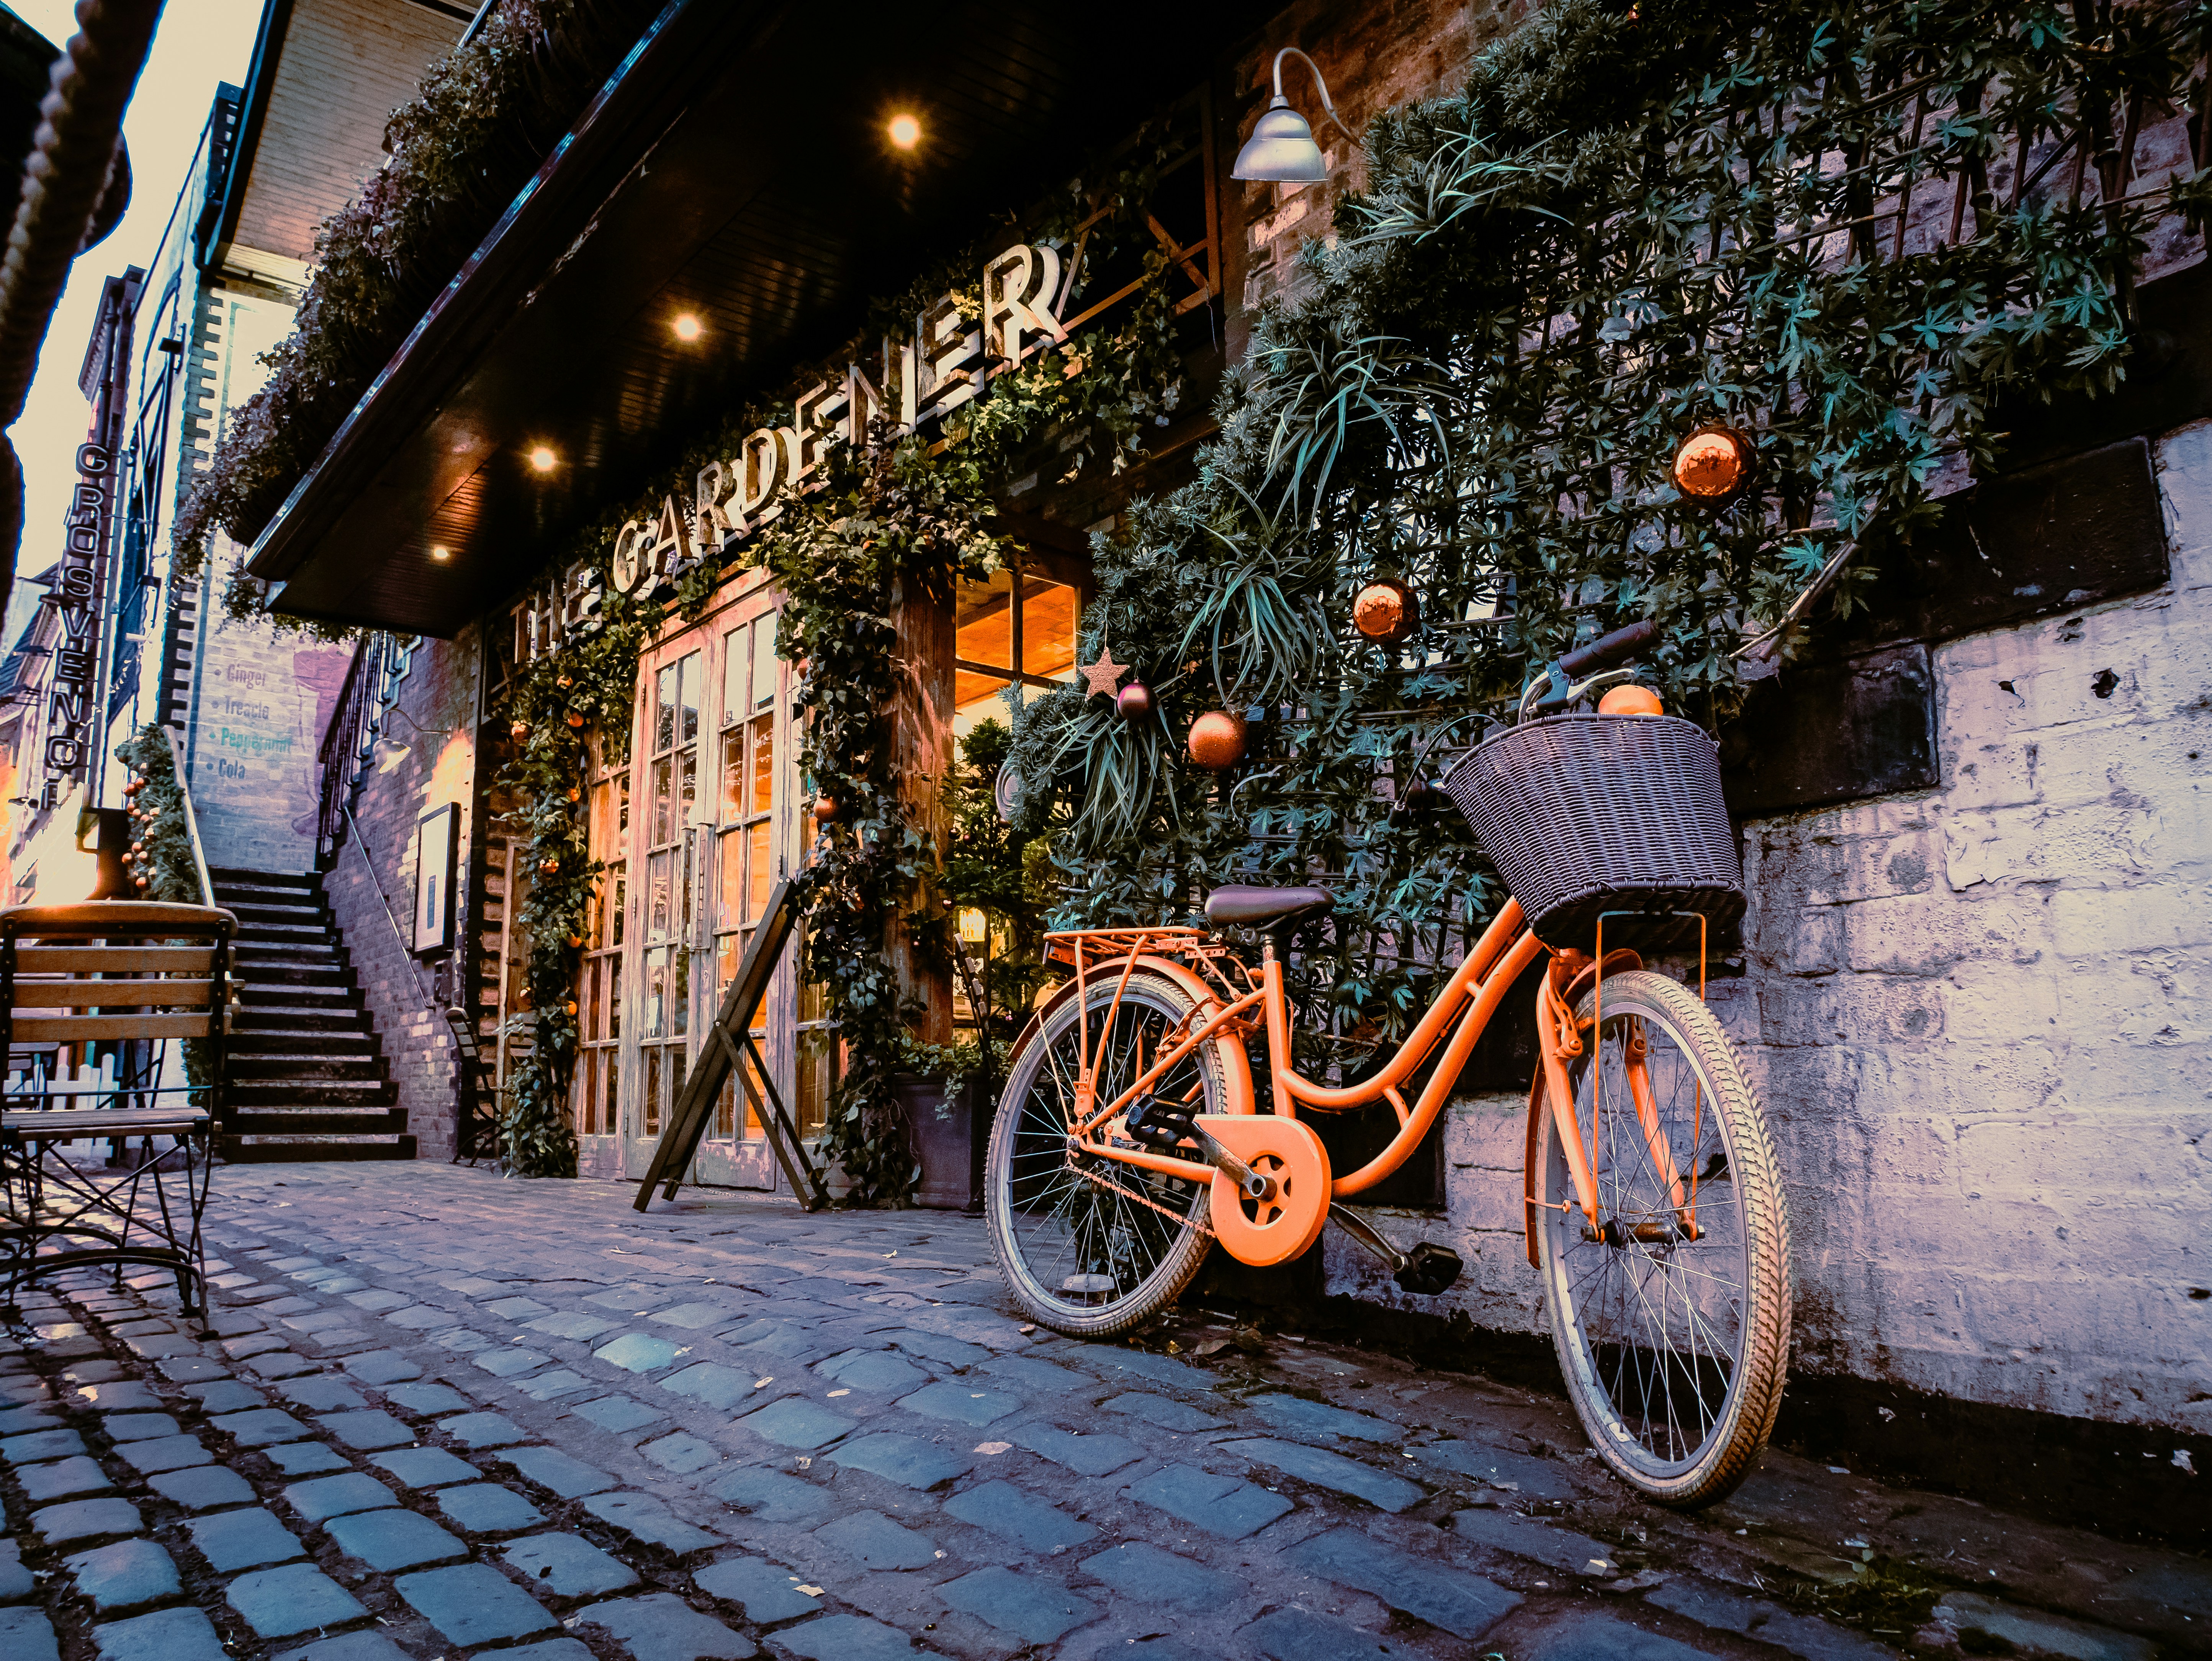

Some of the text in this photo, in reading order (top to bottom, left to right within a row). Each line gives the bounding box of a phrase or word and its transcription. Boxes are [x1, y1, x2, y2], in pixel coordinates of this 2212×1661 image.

[510, 244, 1068, 664] THE GARDENER
[226, 664, 267, 690] Ginger
[225, 696, 270, 719] Treacle
[219, 758, 245, 779] Cola
